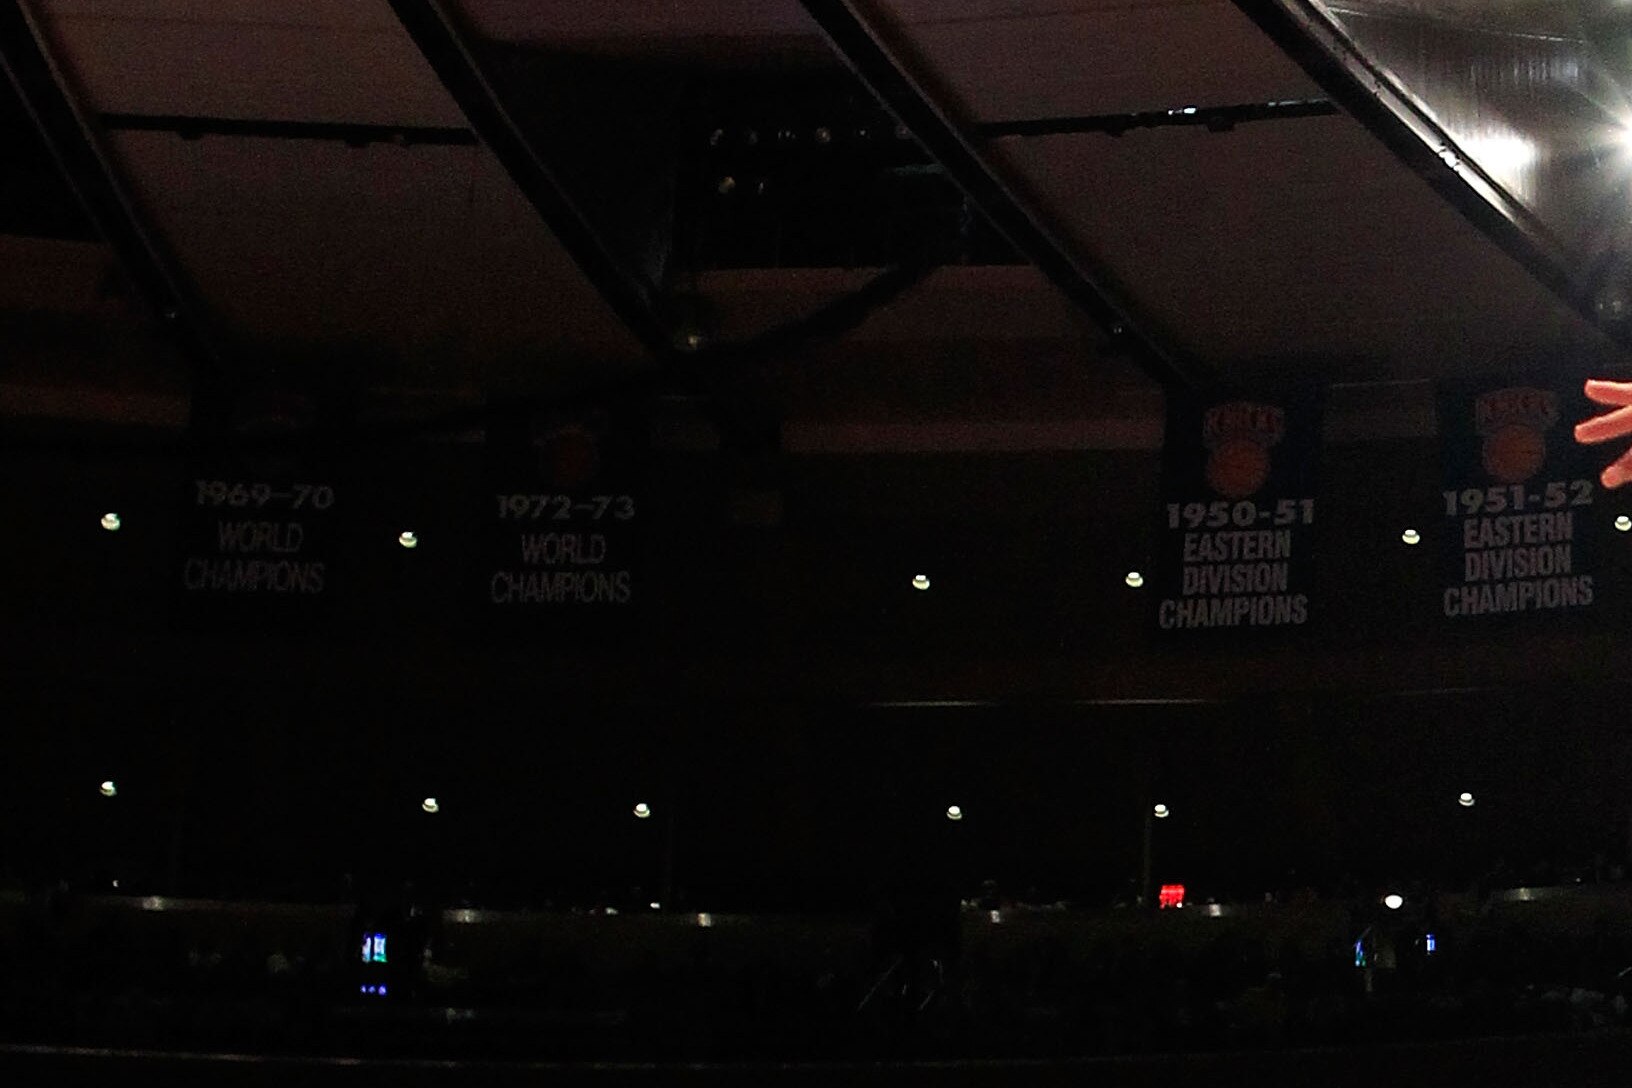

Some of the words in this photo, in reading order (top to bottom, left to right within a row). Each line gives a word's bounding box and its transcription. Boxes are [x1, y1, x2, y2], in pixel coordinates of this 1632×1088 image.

[194, 479, 336, 511] 1969-70
[496, 494, 636, 521] 1972-73
[1443, 480, 1593, 516] 1951-52
[1167, 499, 1314, 530] 1950-51
[1464, 511, 1573, 548] EASTERN
[217, 519, 303, 553] WORLD
[520, 533, 606, 565] WORLD
[1183, 530, 1291, 562] EASTERN
[183, 558, 326, 594] CHAMPIONS
[1465, 543, 1571, 582] DIVISION
[489, 570, 632, 603] CHAMPIONS
[1183, 563, 1288, 596] DIVISION
[1443, 576, 1593, 616] CHAMPIONS
[1159, 594, 1308, 630] CHAMPIONS
